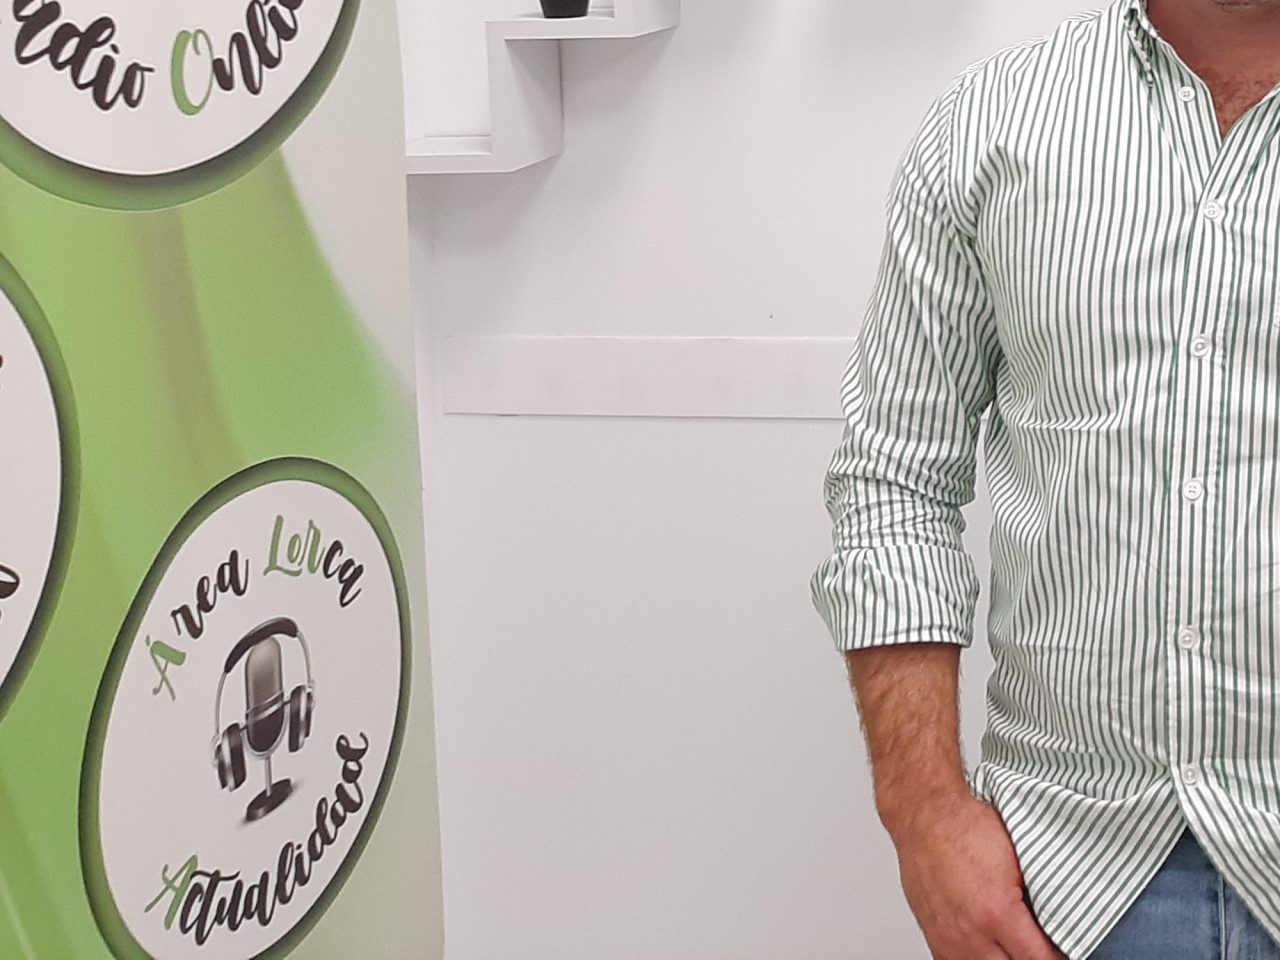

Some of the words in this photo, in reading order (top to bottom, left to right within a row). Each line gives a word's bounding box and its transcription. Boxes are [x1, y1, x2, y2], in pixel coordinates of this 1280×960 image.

[145, 549, 250, 701] Área
[263, 514, 364, 608] Lorca
[144, 731, 370, 947] Actualidad
